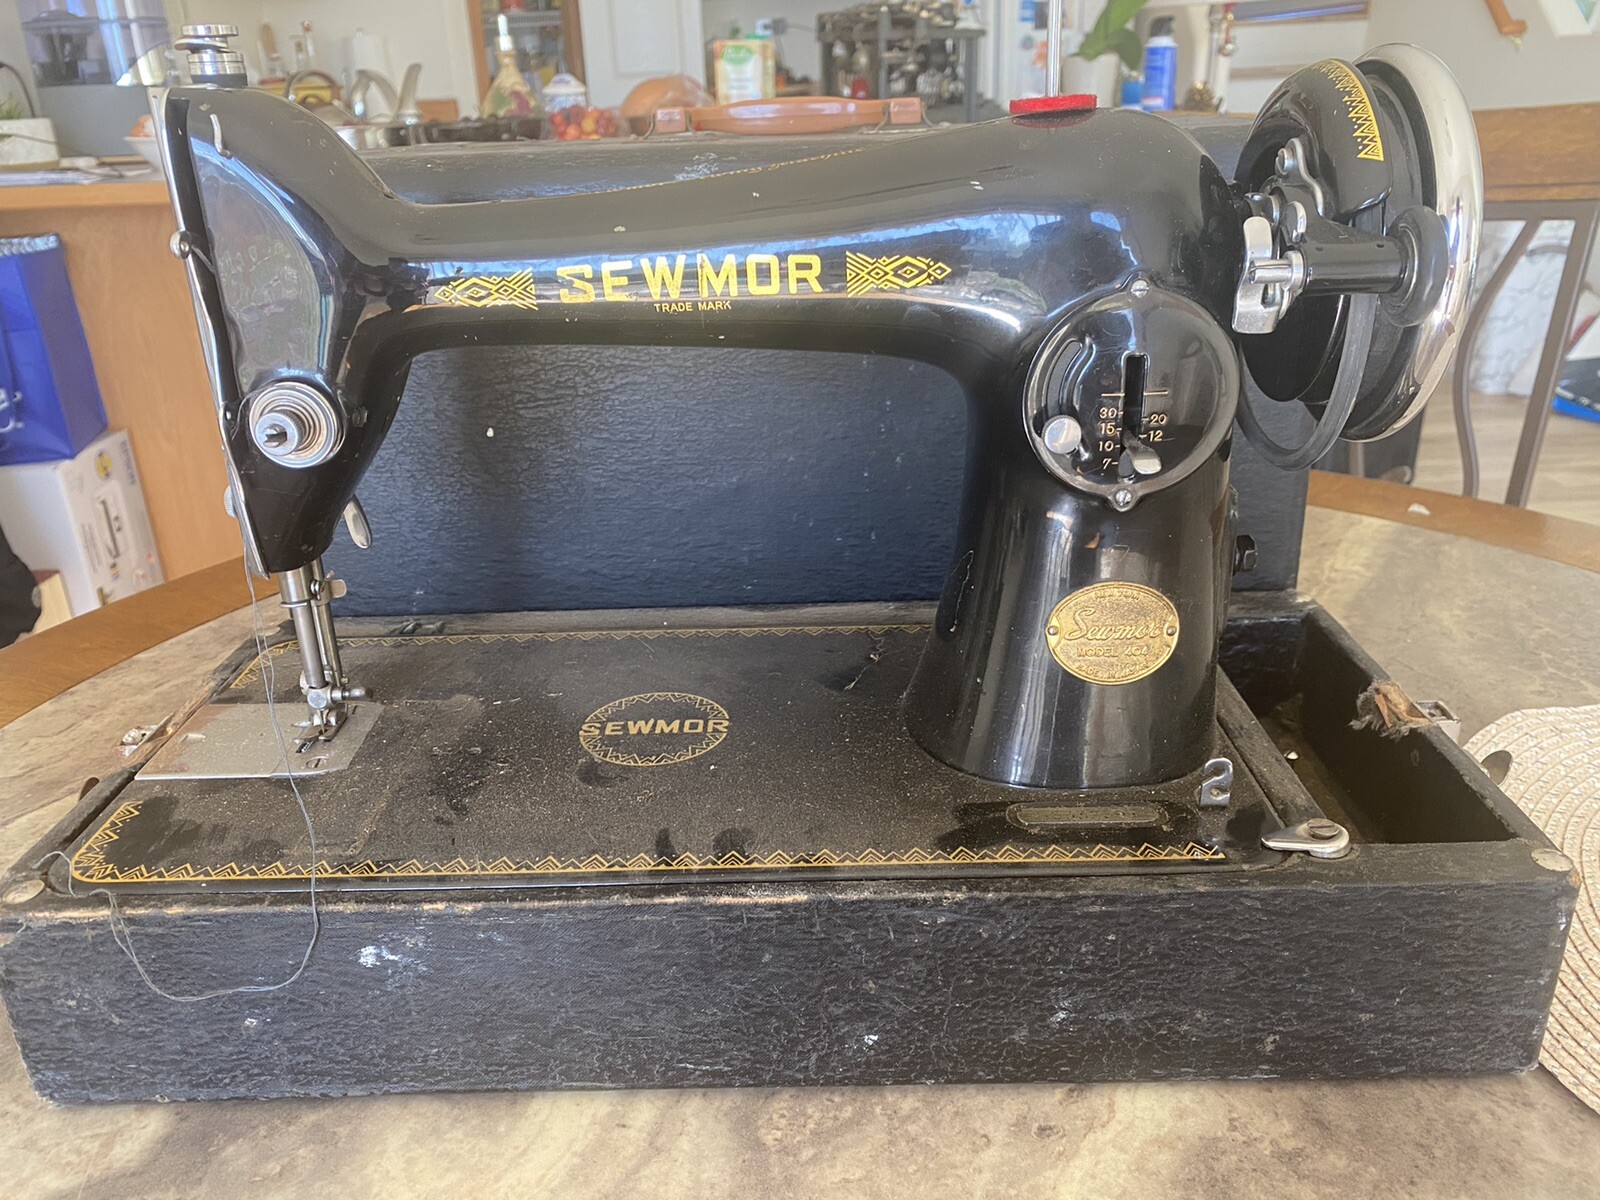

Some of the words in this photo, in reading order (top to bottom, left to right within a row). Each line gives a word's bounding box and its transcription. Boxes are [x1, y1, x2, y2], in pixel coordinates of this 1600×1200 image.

[557, 253, 824, 303] SEWMOR
[653, 302, 693, 313] TRADE
[698, 300, 732, 311] MARK
[1099, 407, 1117, 419] 30
[1150, 413, 1167, 425] 20
[1100, 423, 1115, 435] 15
[1149, 430, 1163, 442] 12
[1098, 441, 1114, 452] 10
[1102, 457, 1112, 470] 7
[1076, 646, 1118, 658] MODEL
[579, 719, 730, 736] SEWMOR
